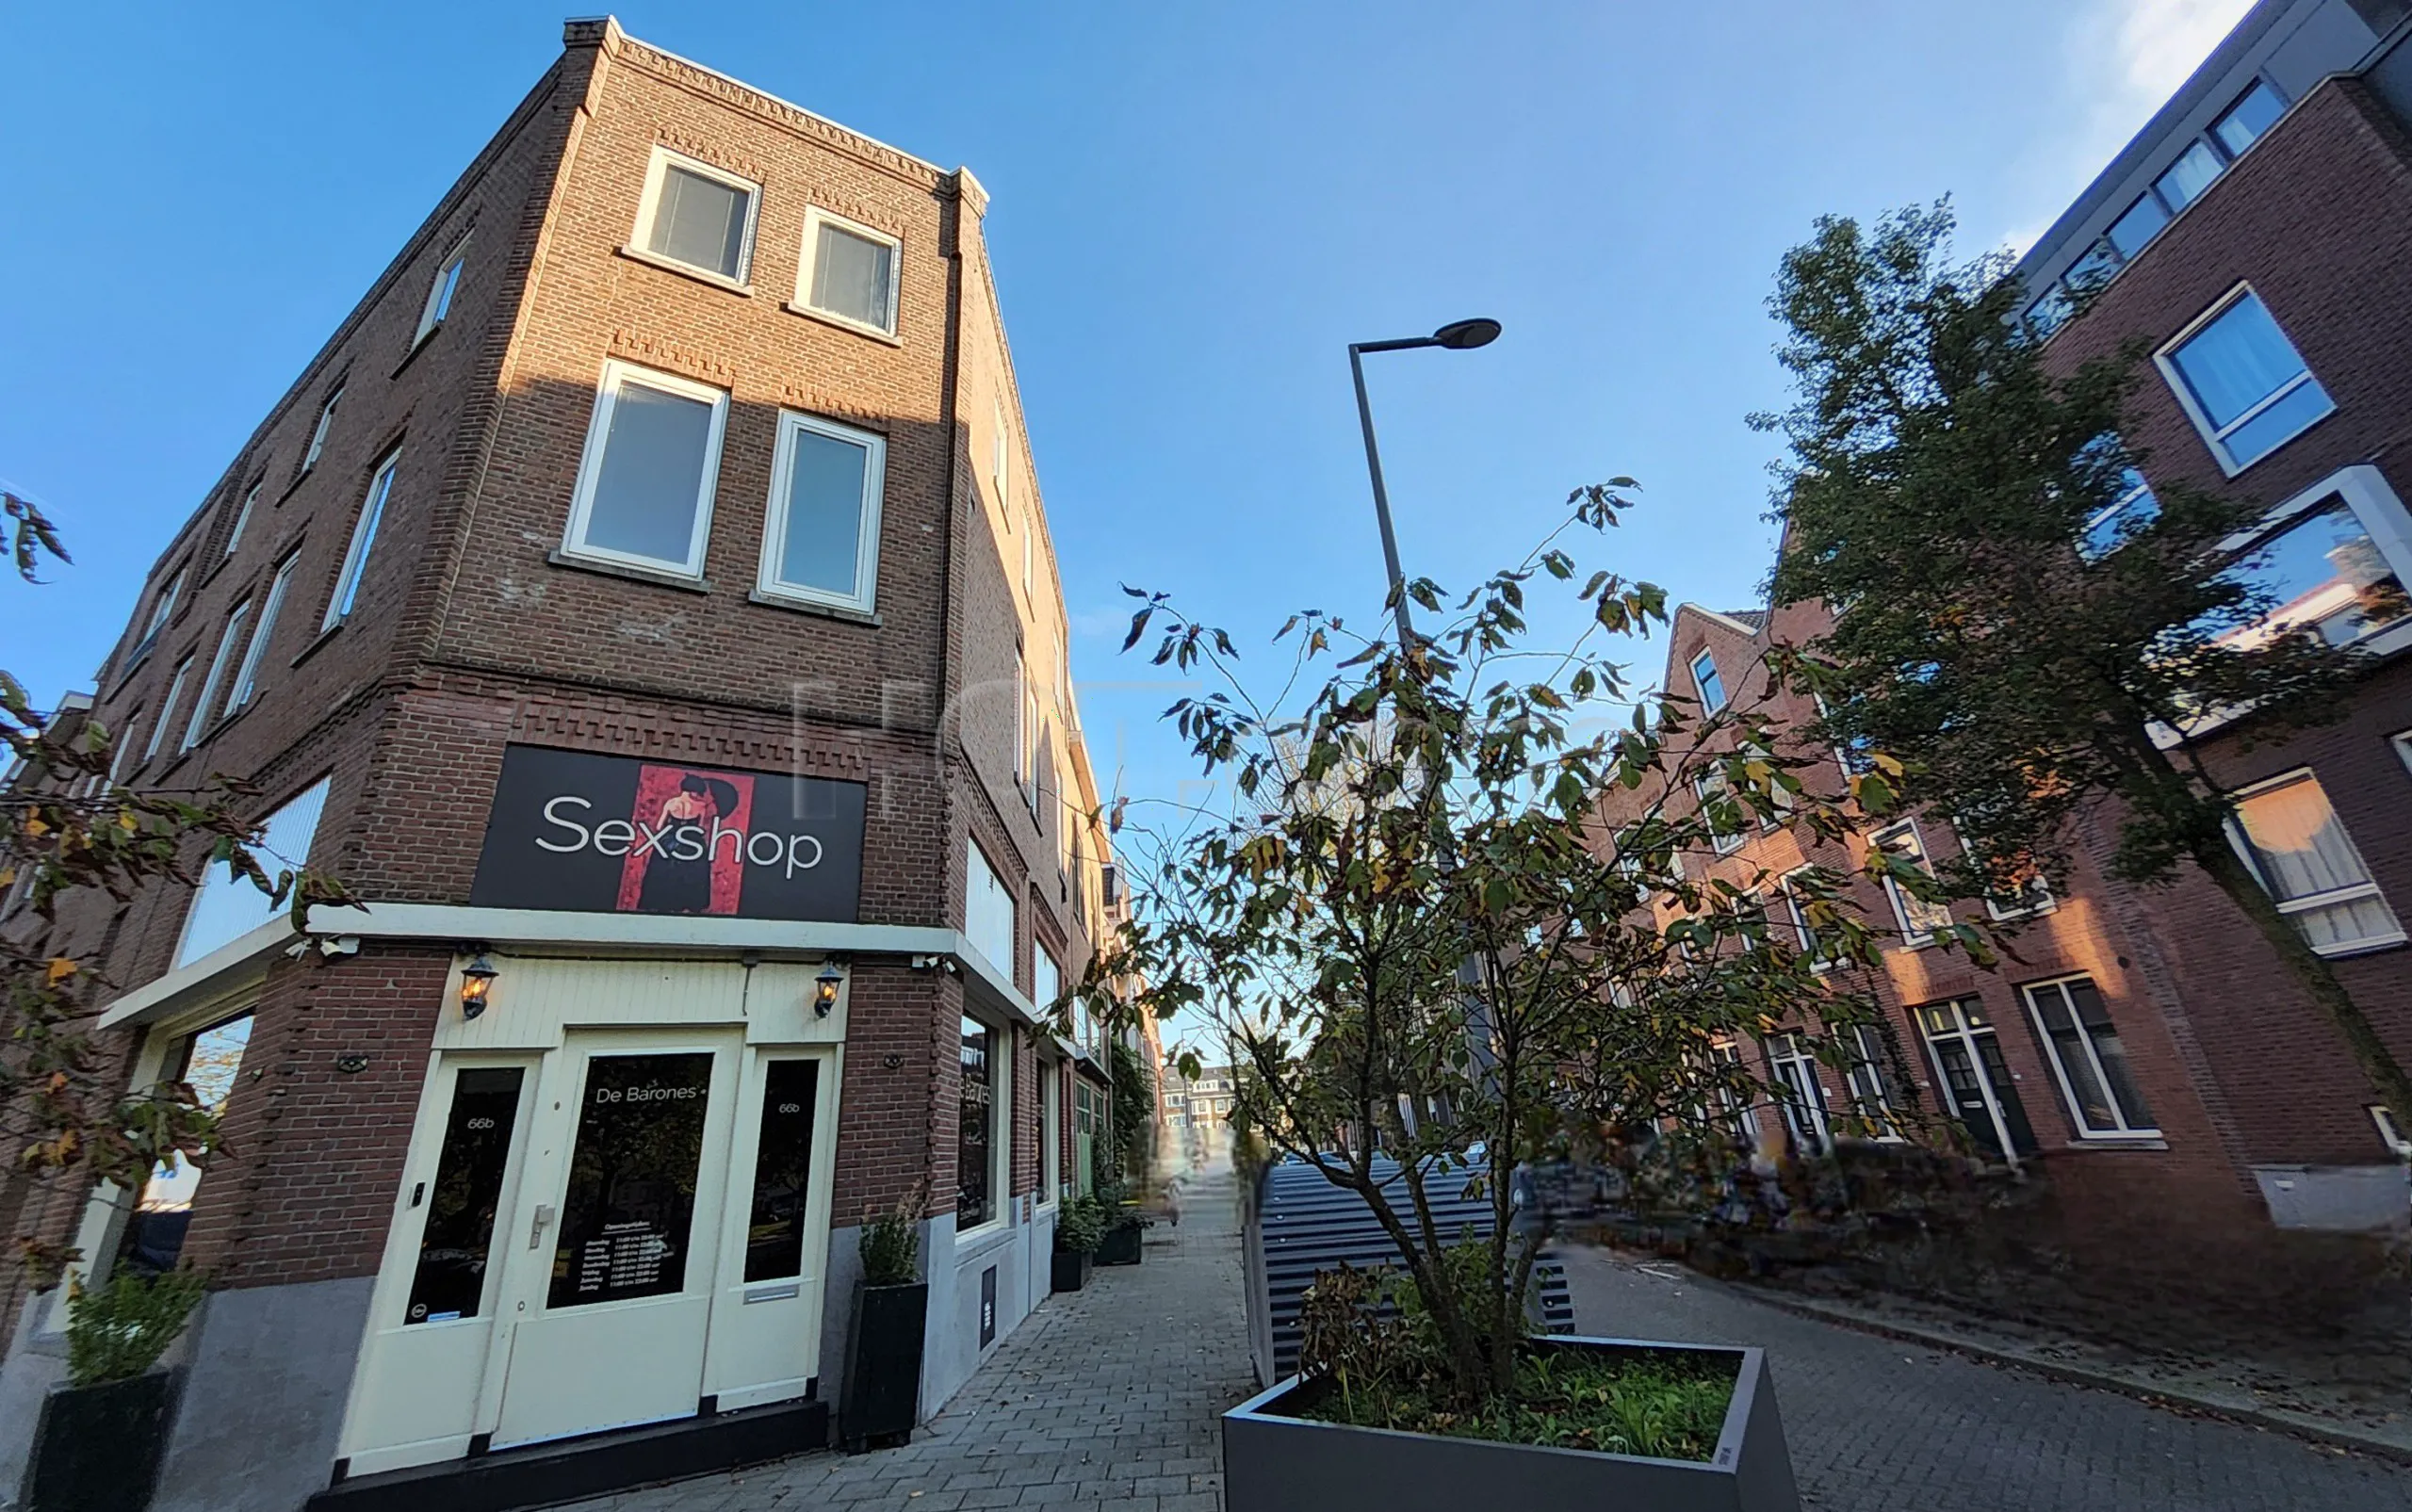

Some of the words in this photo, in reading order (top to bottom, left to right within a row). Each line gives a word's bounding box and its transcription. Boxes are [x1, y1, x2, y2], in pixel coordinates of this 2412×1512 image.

[534, 795, 823, 880] Sexshop
[596, 1087, 622, 1104] De
[626, 1086, 697, 1102] Barones
[778, 1102, 800, 1114] 66b
[467, 1117, 495, 1130] 66b
